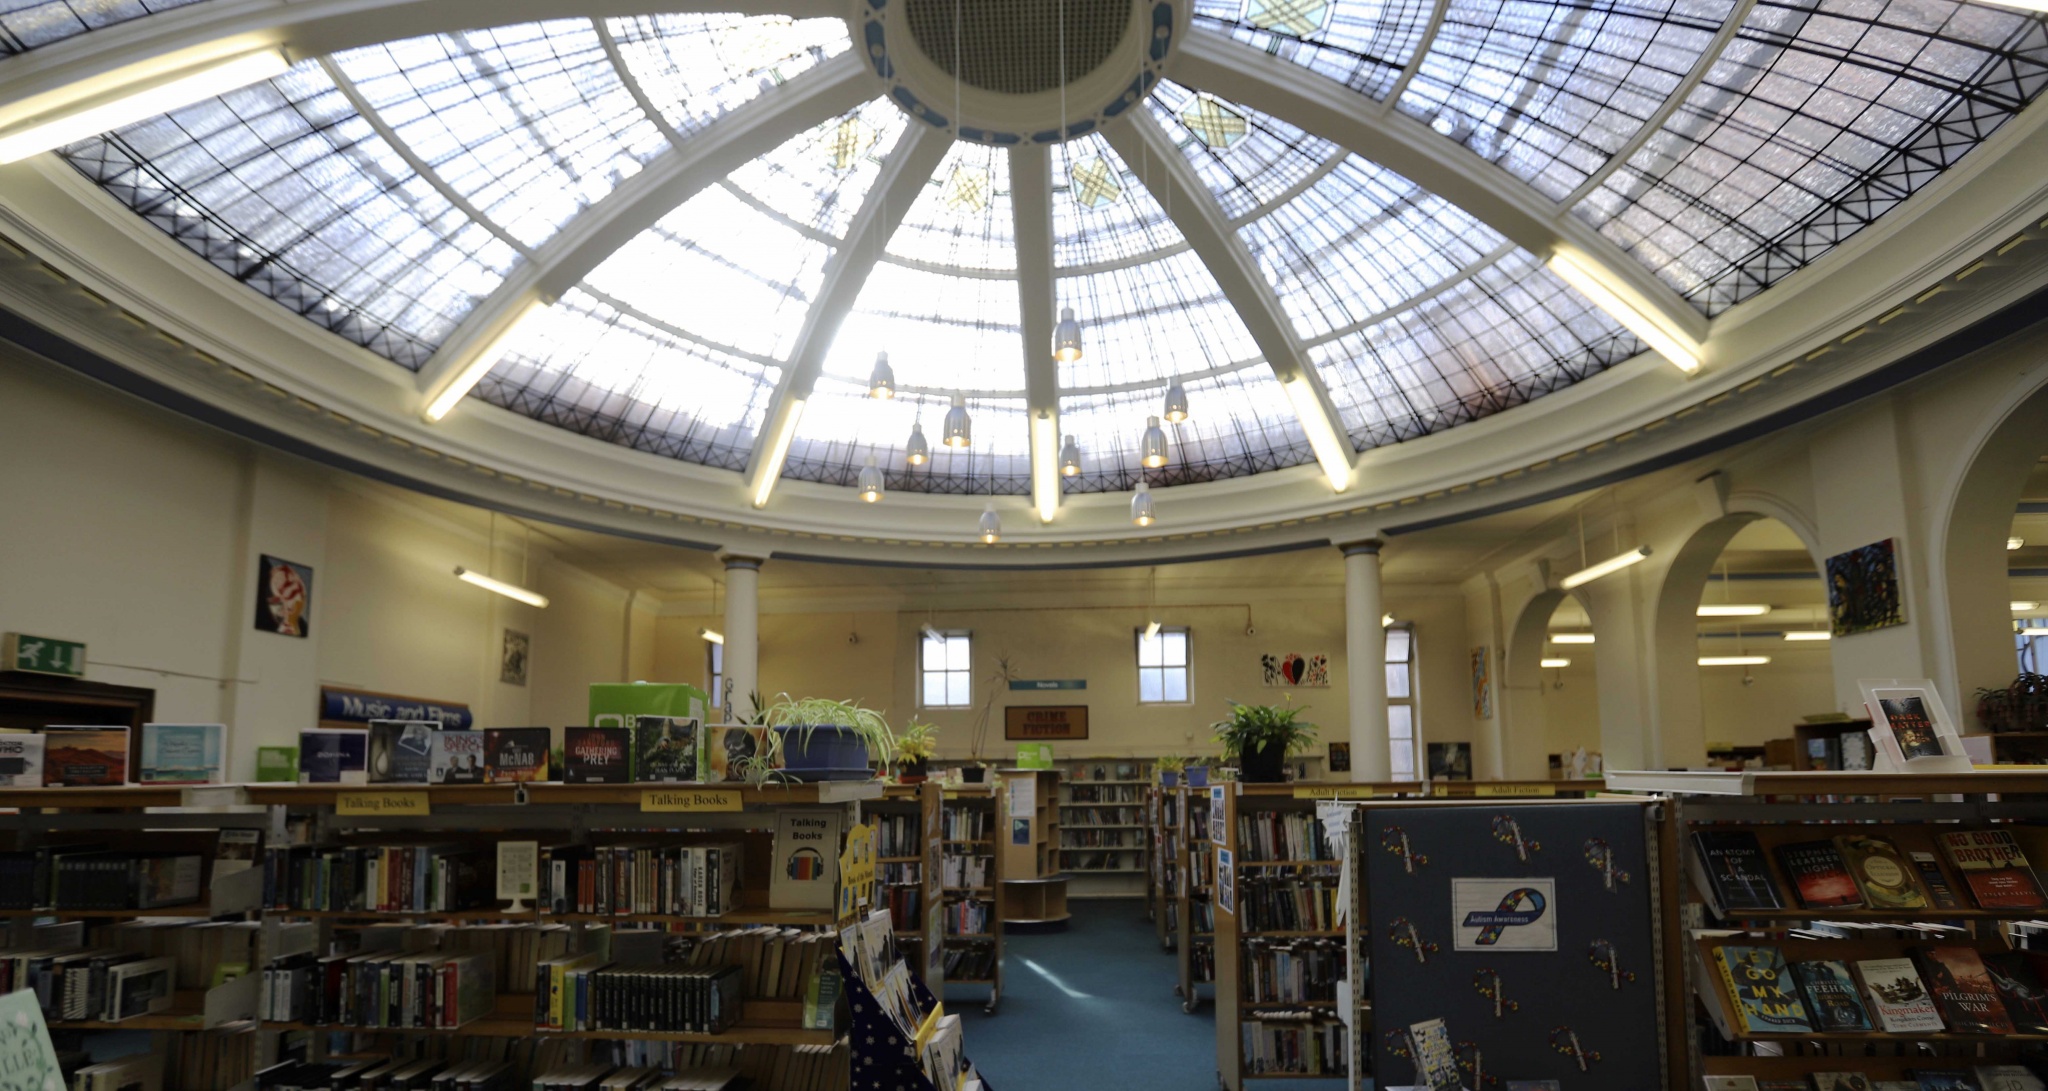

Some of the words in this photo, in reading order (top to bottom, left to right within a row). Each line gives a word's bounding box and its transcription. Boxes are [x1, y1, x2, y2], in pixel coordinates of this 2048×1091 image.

[1037, 681, 1059, 689] Novels
[342, 695, 392, 719] Music
[395, 705, 424, 721] and
[427, 706, 462, 724] Films
[1026, 711, 1066, 723] CRIME
[1889, 713, 1921, 721] DARK
[1023, 723, 1071, 736] FICTION
[575, 746, 618, 756] GATHERING
[499, 752, 535, 767] McNAB
[583, 753, 610, 765] PREY
[1309, 787, 1330, 796] Adult
[1332, 786, 1358, 796] Fiction
[1491, 785, 1513, 794] Adult
[1514, 785, 1540, 794] Fiction
[343, 797, 380, 810] Talking
[383, 796, 415, 808] Books
[650, 794, 690, 807] Talking
[694, 794, 728, 806] Books
[790, 818, 827, 830] Talking
[792, 832, 823, 841] Books
[1946, 833, 1969, 847] NO
[1971, 831, 2013, 846] GOOD
[1953, 845, 2023, 863] BROTHER
[1731, 857, 1743, 865] OF
[1789, 855, 1840, 867] LEATHER
[1801, 863, 1837, 874] LIGHT
[1470, 915, 1492, 923] Autism
[1493, 915, 1529, 923] Awareness
[1734, 950, 1776, 963] LET
[1745, 968, 1777, 981] GO
[1751, 985, 1783, 998] MY
[1805, 985, 1856, 994] FEEHAN
[1941, 992, 1997, 1003] PILGRIM'S
[1743, 1004, 1805, 1017] HAND
[1879, 1003, 1936, 1018] Kingmaker
[1958, 1001, 1990, 1013] WAR
